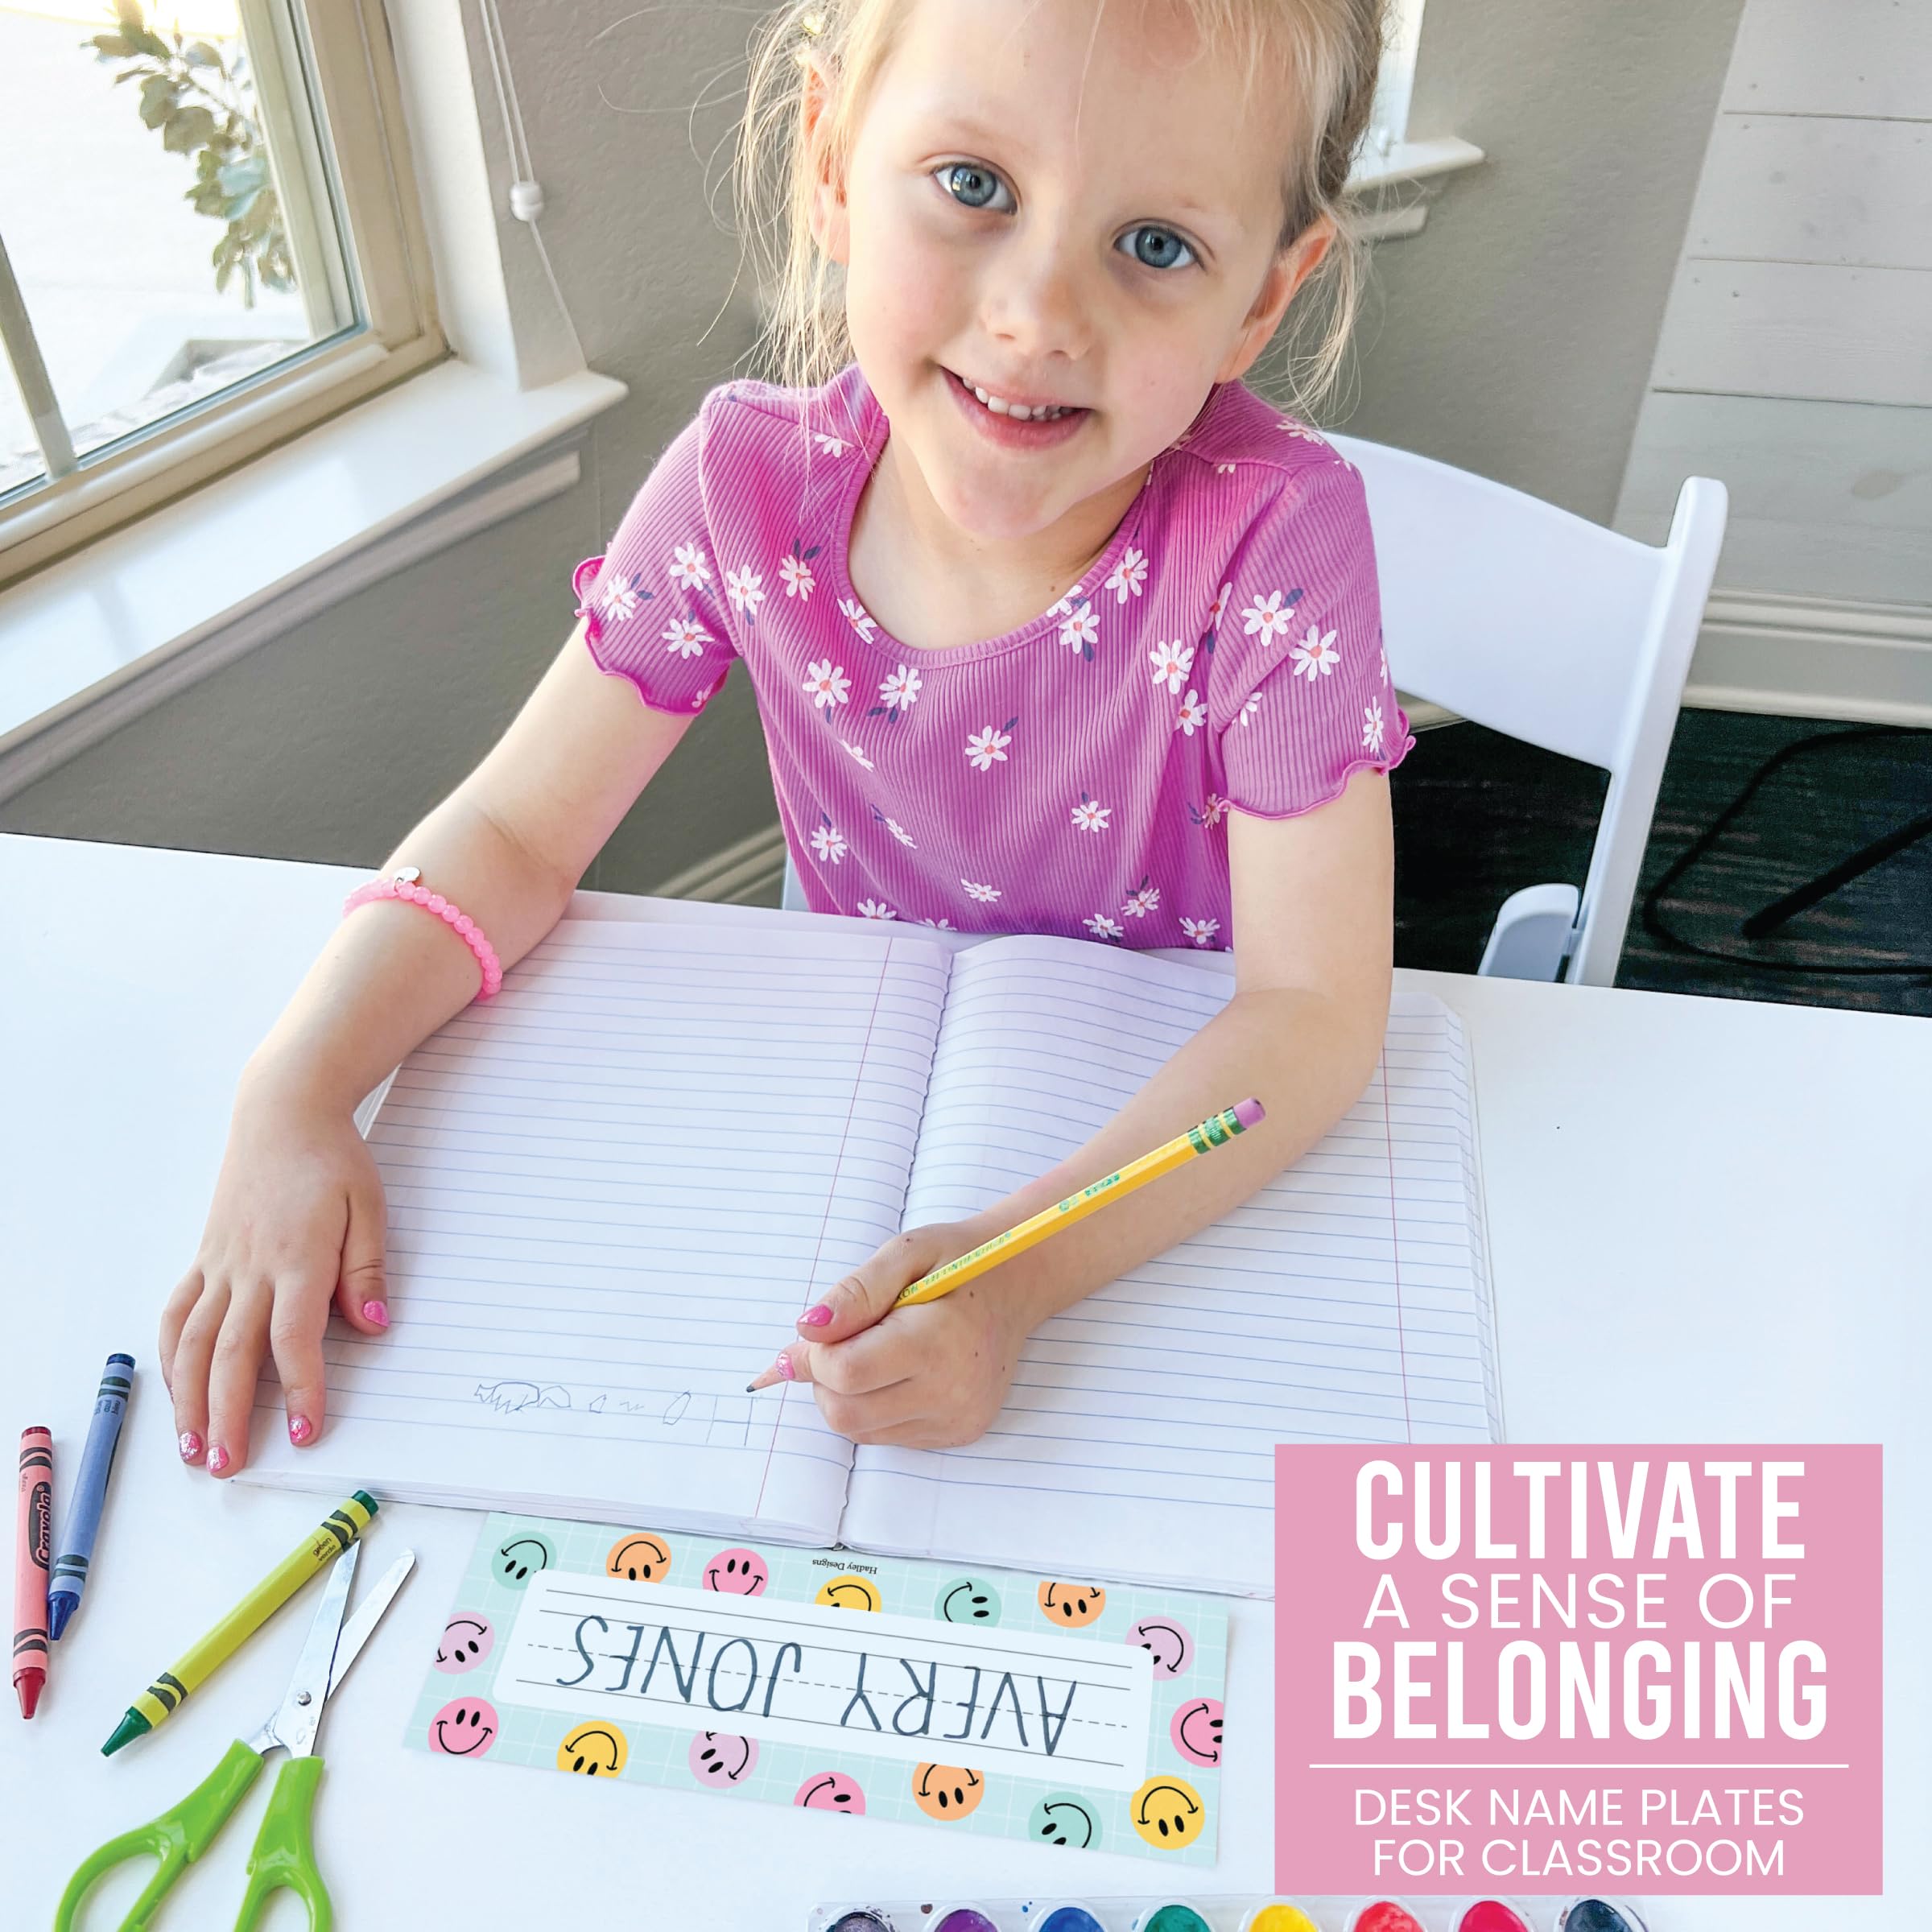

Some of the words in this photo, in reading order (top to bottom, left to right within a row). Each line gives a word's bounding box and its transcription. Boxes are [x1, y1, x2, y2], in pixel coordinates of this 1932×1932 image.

[35, 1492, 52, 1564] Crayola
[312, 1538, 332, 1558] green
[812, 1558, 845, 1571] Designs
[847, 1562, 877, 1575] Hadley
[555, 1615, 802, 1718] JONES
[840, 1653, 1077, 1757] AVERY
